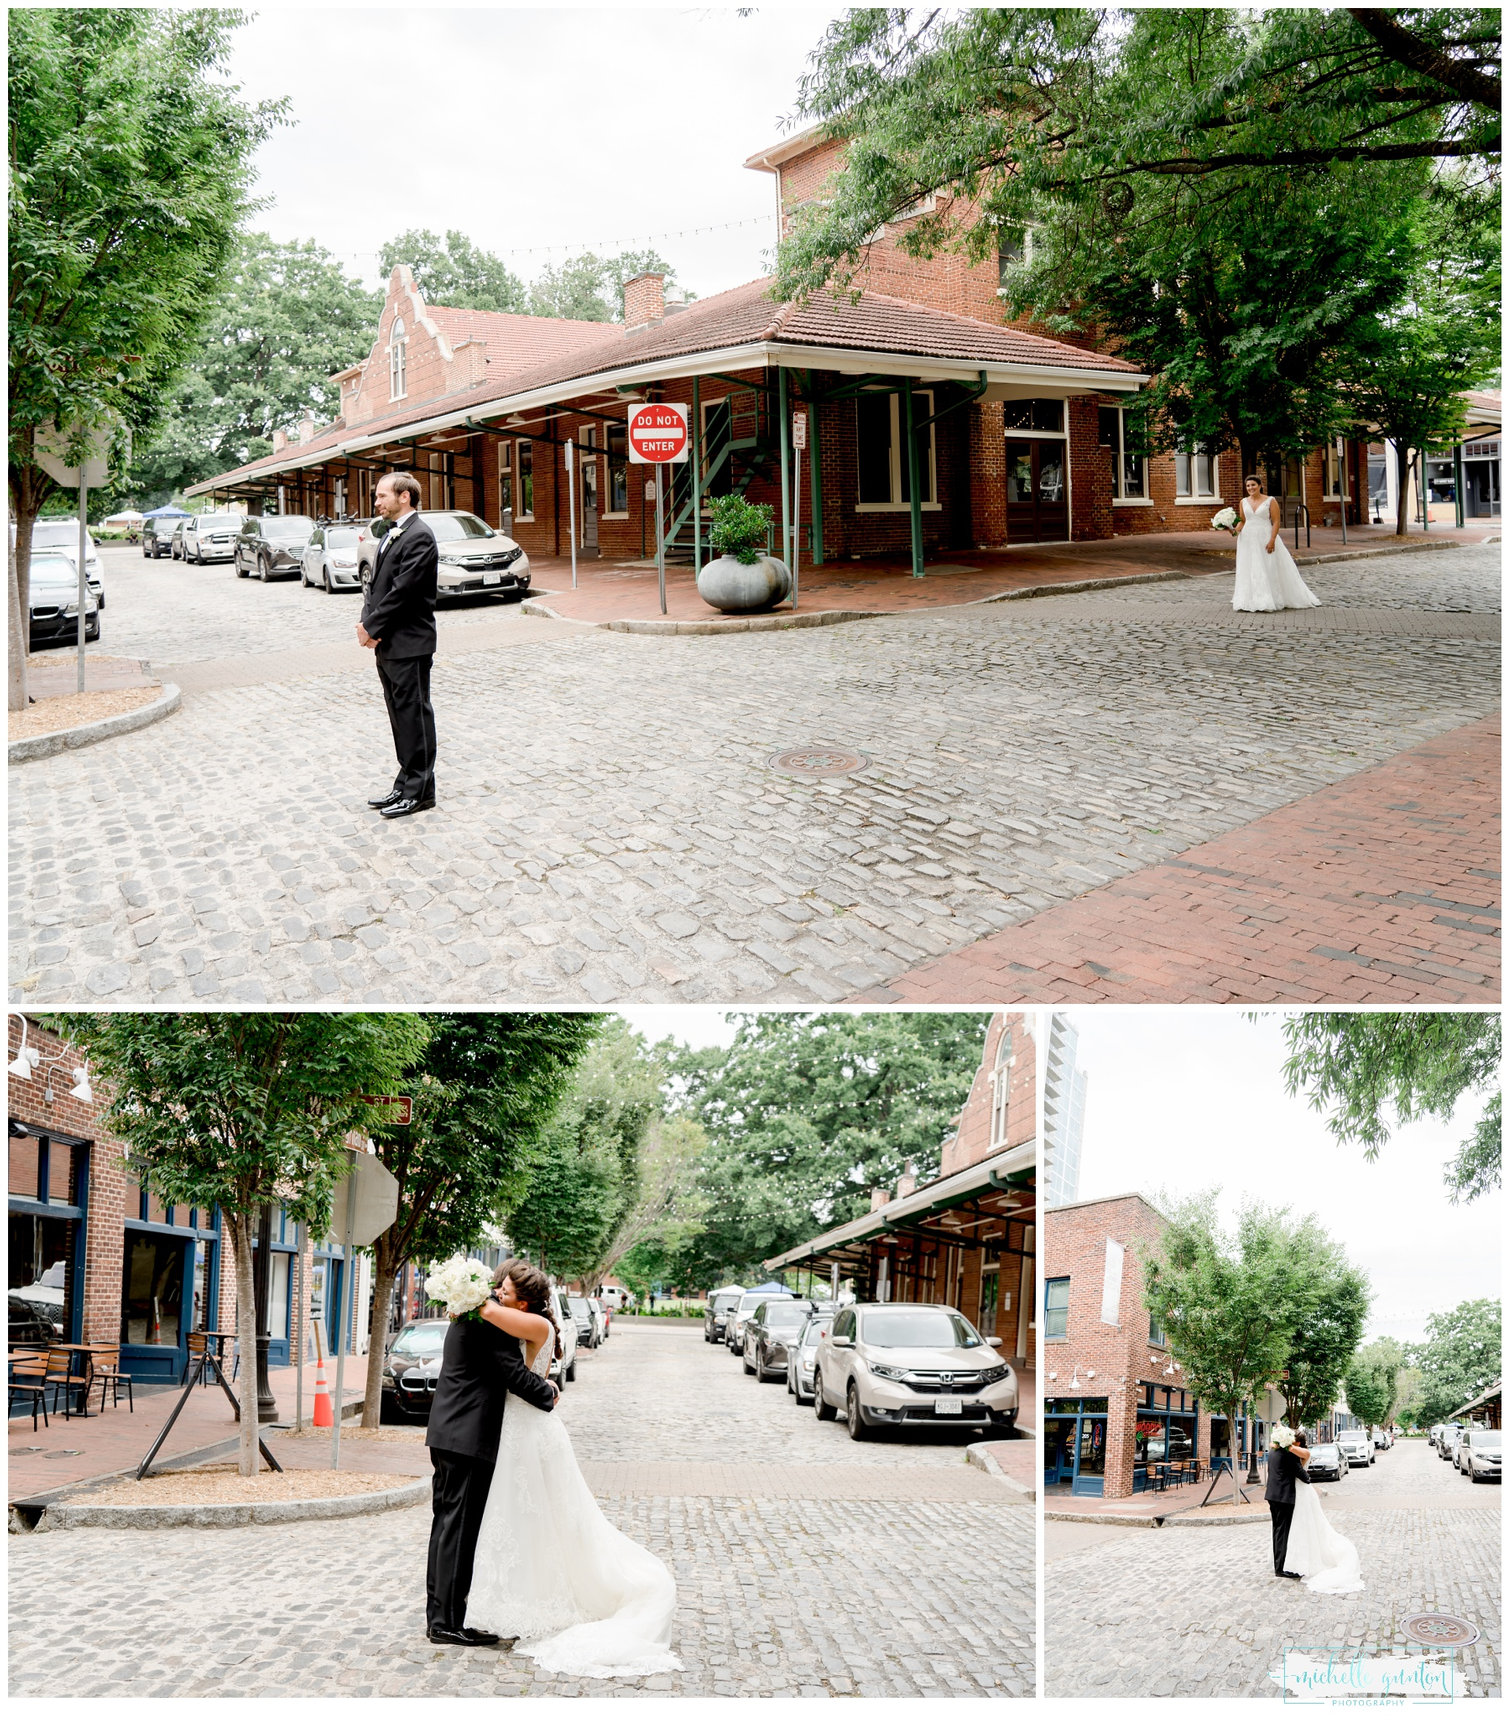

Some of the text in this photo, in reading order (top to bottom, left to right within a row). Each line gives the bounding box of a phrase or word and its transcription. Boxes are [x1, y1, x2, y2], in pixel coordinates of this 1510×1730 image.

[637, 415, 678, 426] DO NOT
[642, 441, 675, 452] ENTER
